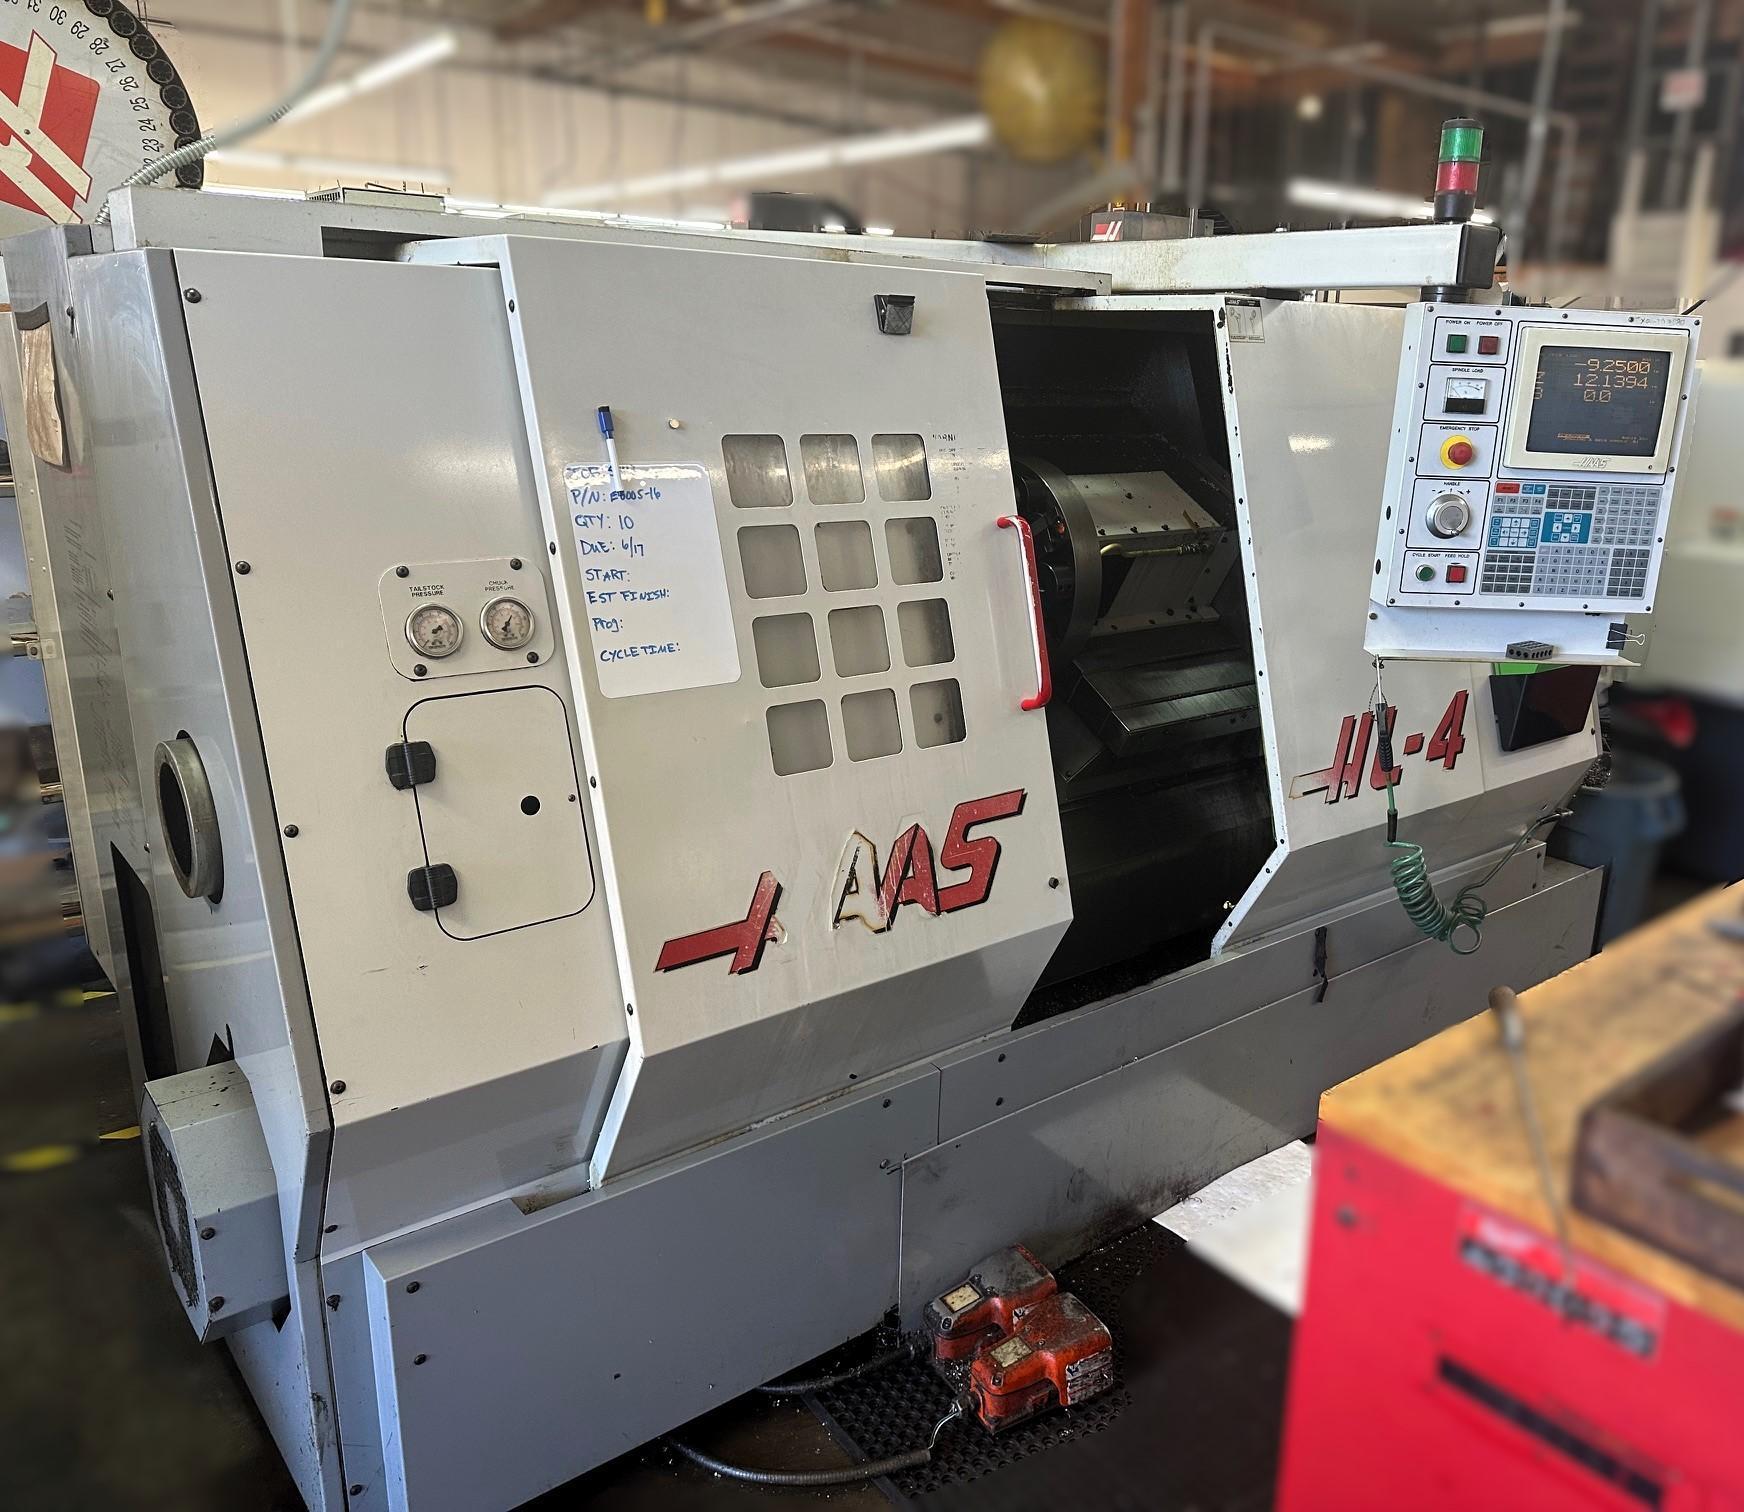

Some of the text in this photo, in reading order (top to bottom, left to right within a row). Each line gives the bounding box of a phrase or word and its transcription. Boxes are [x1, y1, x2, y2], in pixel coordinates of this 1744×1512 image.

[49, 5, 67, 26] 30
[70, 20, 90, 39] 29
[89, 37, 110, 55] 28
[105, 58, 126, 73] 27
[119, 76, 139, 92] 26
[130, 96, 149, 112] 25
[137, 118, 156, 132] 24
[142, 138, 160, 153] 23
[1574, 358, 1651, 374] -9.2500
[1573, 373, 1649, 390] 12.1394
[570, 486, 607, 506] P/N:
[574, 513, 635, 530] QTY: 10
[621, 536, 645, 558] 6/17
[585, 568, 631, 582] START:
[408, 584, 445, 592] TAILSTOCK
[411, 590, 445, 598] PRESSURE
[586, 588, 670, 605] EST FINISH:
